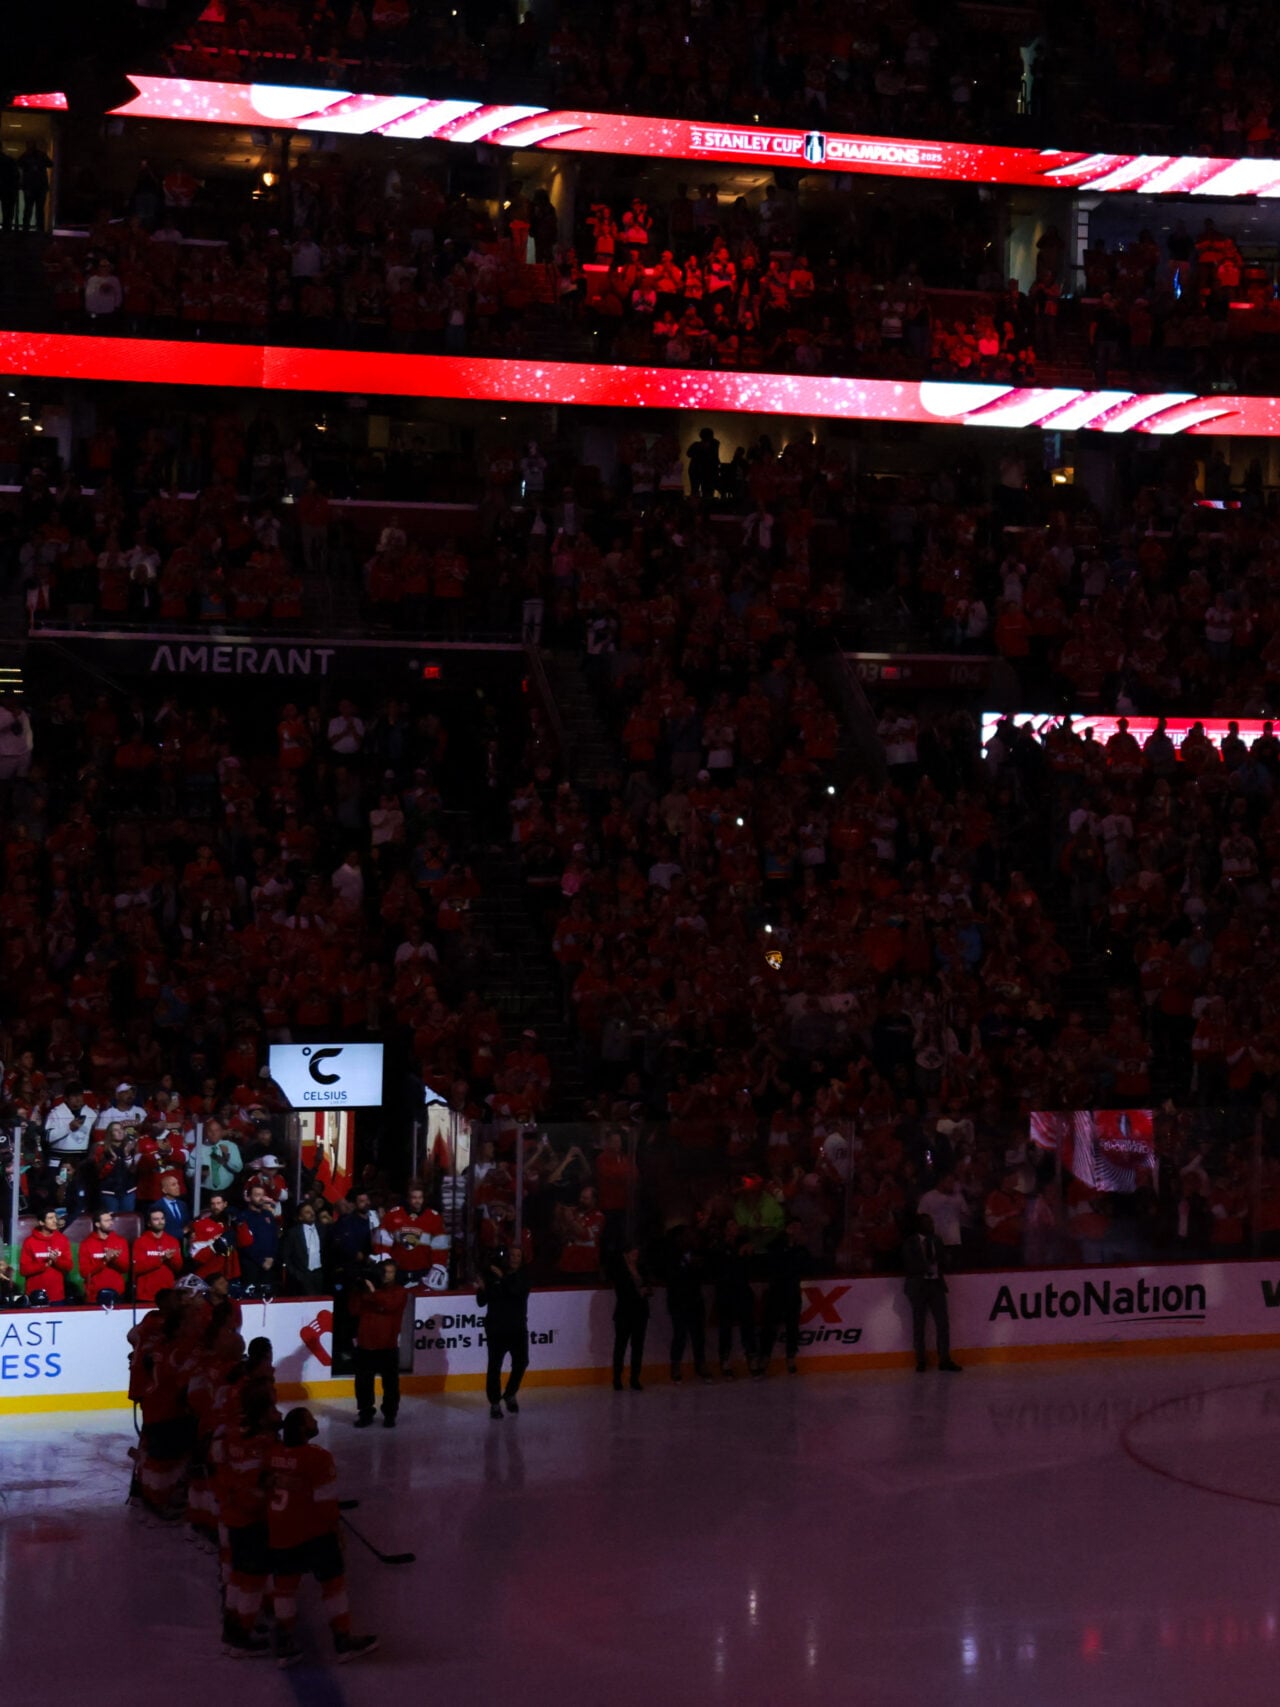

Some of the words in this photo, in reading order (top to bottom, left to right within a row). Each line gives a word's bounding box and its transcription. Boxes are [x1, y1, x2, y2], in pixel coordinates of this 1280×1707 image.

[704, 131, 769, 152] STANLEY
[772, 137, 803, 153] CUP
[826, 141, 920, 164] CHAMPIONS
[150, 645, 336, 675] AMERANT
[303, 1090, 348, 1101] CELSIUS
[988, 1278, 1206, 1321] AutoNation
